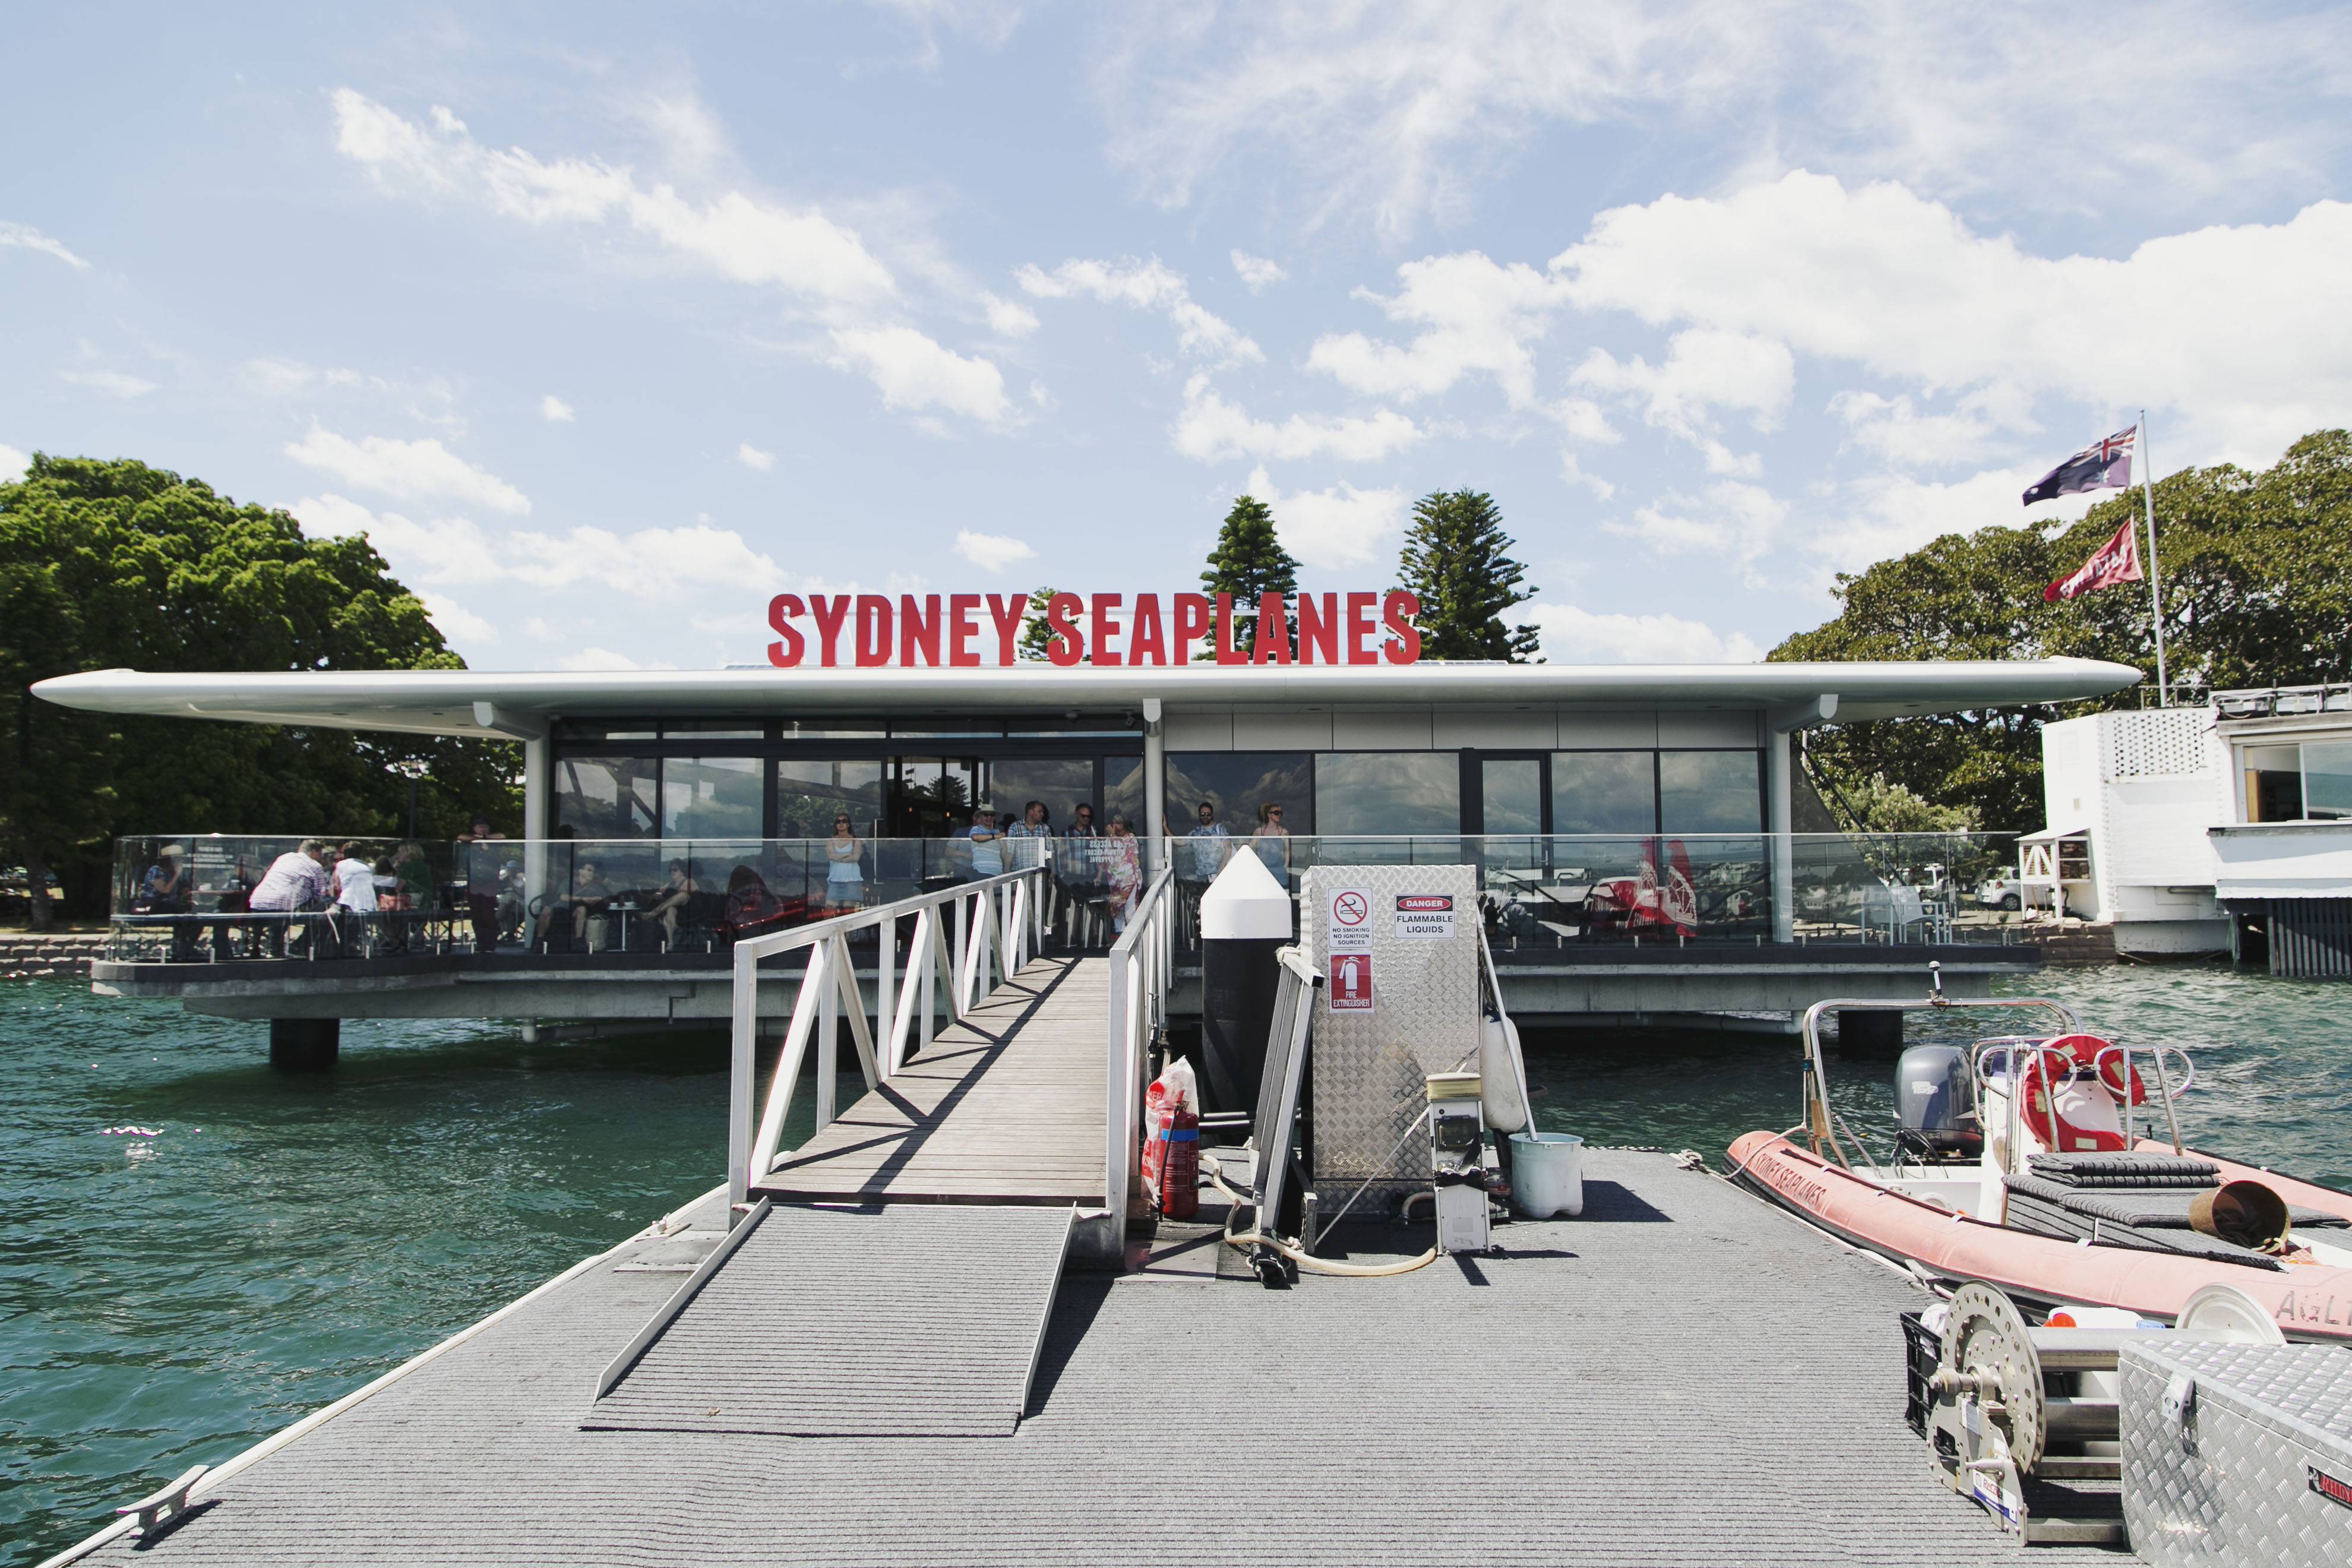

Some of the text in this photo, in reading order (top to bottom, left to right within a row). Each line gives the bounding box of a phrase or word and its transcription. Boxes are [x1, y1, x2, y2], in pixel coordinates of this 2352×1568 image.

[767, 591, 1421, 667] SYDNEY SEAPLANES
[1333, 999, 1370, 1007] EXTINGUISHER
[1754, 1153, 1826, 1207] SYDNEY SEAPLANES
